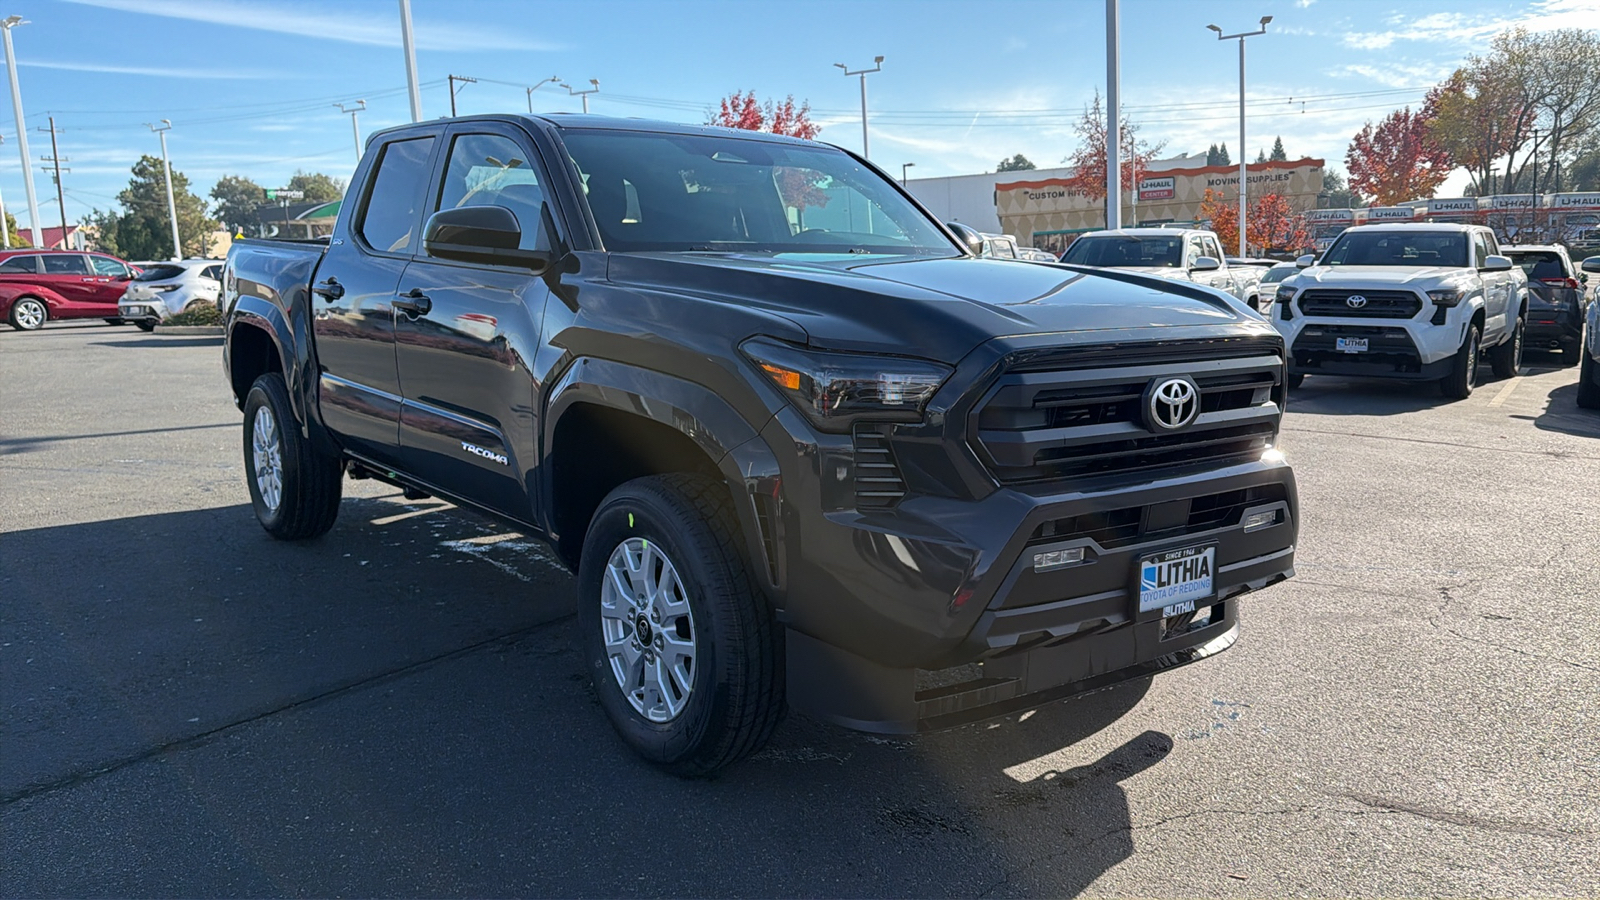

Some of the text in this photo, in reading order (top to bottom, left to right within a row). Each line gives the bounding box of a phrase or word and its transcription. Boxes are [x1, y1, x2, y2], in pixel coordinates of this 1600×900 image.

[1246, 174, 1289, 183] SUPPLIES
[1029, 191, 1065, 200] CUSTOM
[461, 441, 508, 466] TACOMA
[1165, 548, 1195, 560] SINCE 1946
[1157, 555, 1210, 588] LITHIA
[1168, 587, 1178, 597] OF
[1179, 579, 1211, 595] REDDING
[1171, 600, 1196, 614] LITHIA
